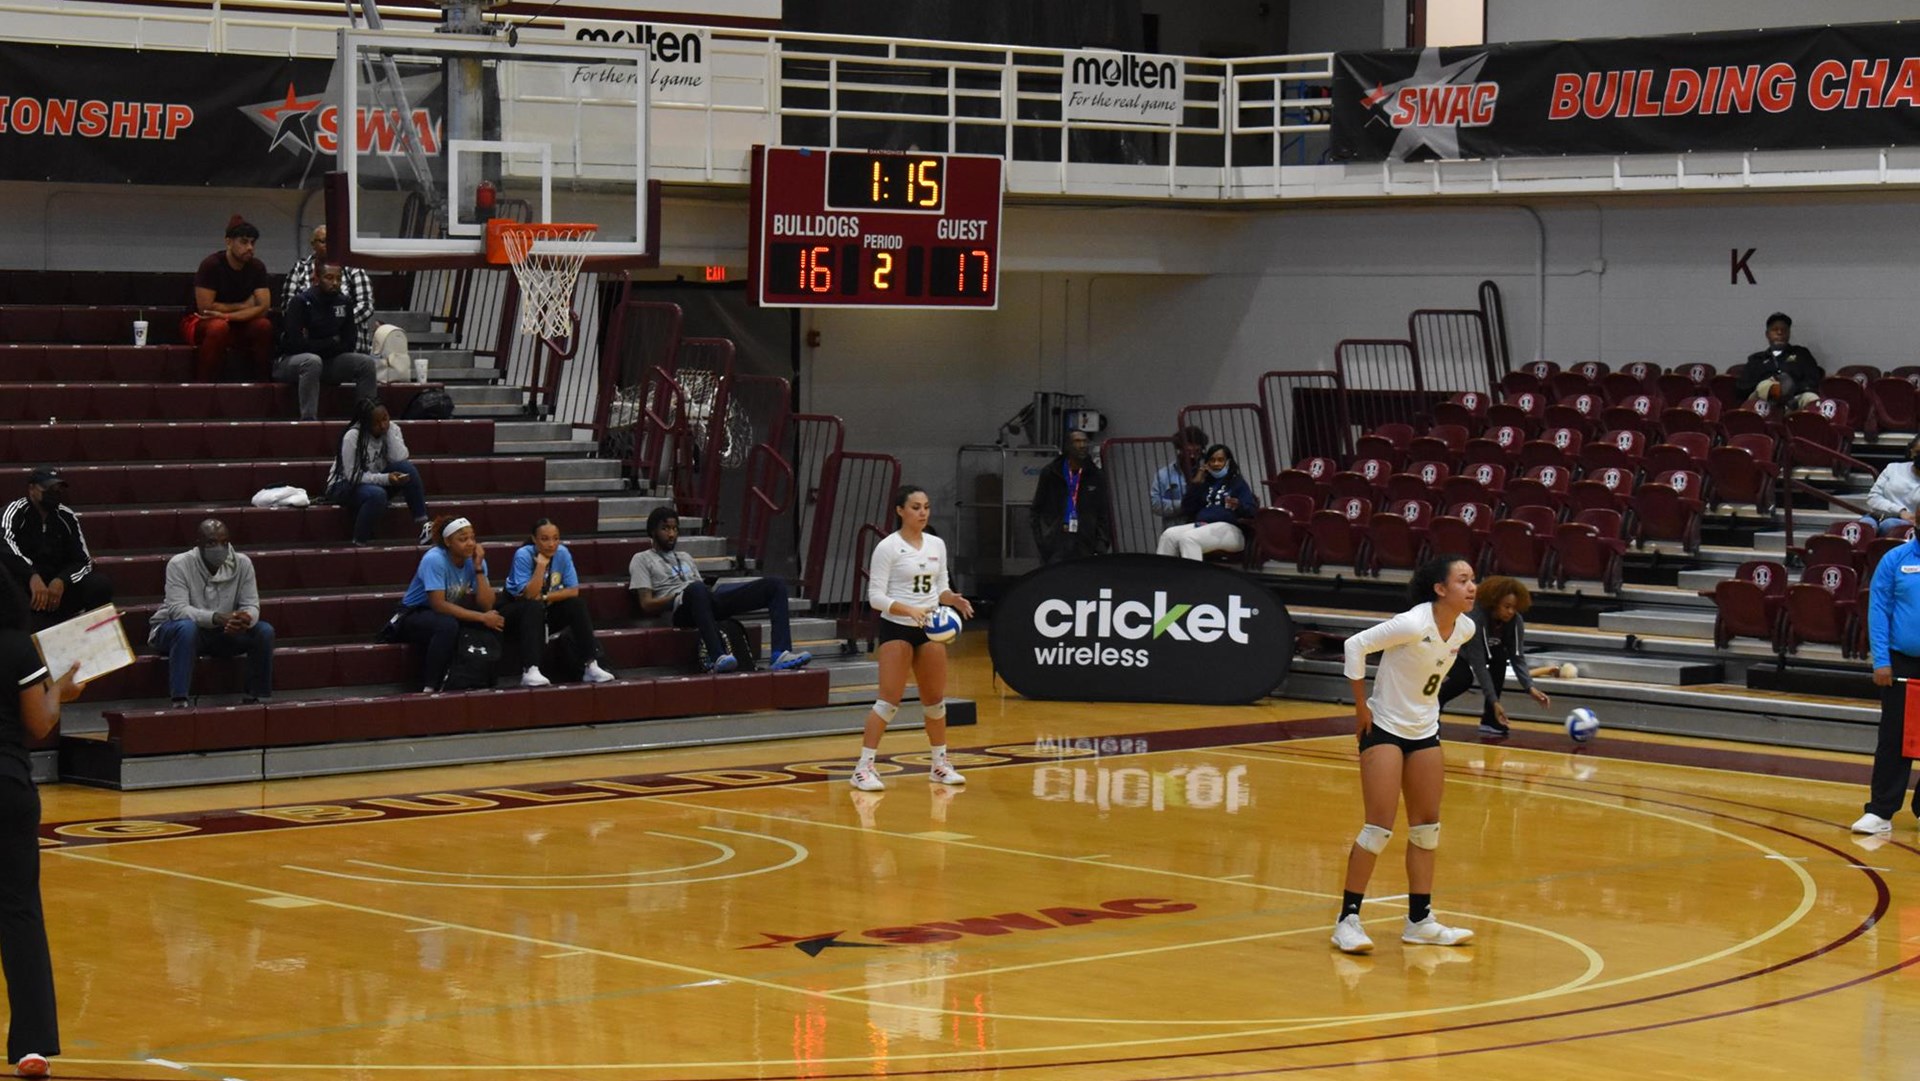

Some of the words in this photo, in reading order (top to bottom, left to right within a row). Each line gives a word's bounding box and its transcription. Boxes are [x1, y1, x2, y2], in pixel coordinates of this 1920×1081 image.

[572, 66, 598, 83] For
[599, 67, 624, 84] the
[625, 68, 660, 85] rl
[659, 75, 702, 91] game
[1072, 54, 1176, 90] molten
[1548, 62, 1797, 120] BUILDING
[1807, 57, 1920, 111] CHA
[1068, 91, 1090, 107] For
[1091, 91, 1112, 107] the
[1113, 93, 1141, 109] real
[1140, 100, 1177, 115] game
[1390, 81, 1499, 129] SWAC
[314, 104, 443, 157] SWA
[773, 214, 860, 237] BULLDOGS
[863, 234, 903, 249] PERIOD
[937, 219, 988, 240] GUEST
[800, 246, 831, 293] 16
[873, 252, 893, 289] 2
[958, 250, 989, 292] 17
[1731, 248, 1757, 284] K
[912, 574, 932, 594] 15
[1034, 588, 1252, 644] cricket
[1034, 642, 1150, 668] wireless
[1422, 673, 1441, 697] 8
[861, 897, 1198, 944] SWAC
